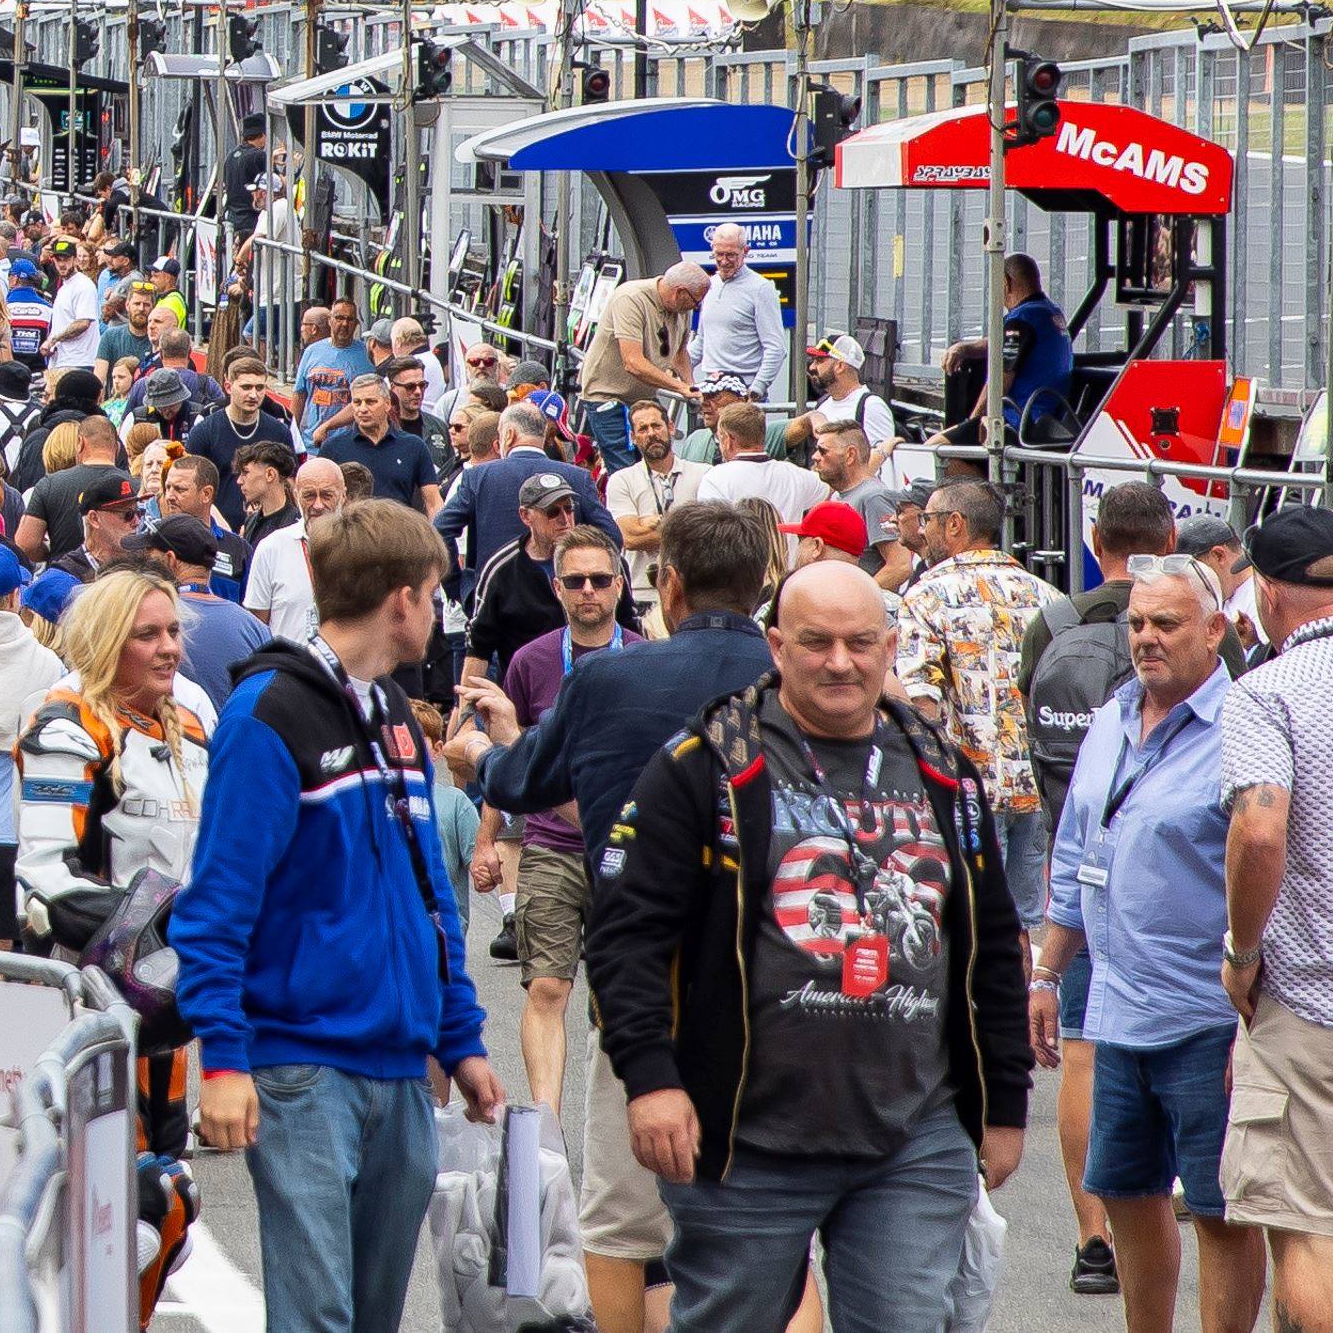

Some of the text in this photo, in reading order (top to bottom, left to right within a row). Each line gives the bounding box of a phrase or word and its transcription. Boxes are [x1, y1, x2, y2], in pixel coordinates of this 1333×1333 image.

[1055, 121, 1209, 194] McAMS
[710, 182, 766, 205] OMG
[742, 224, 782, 241] MAHA
